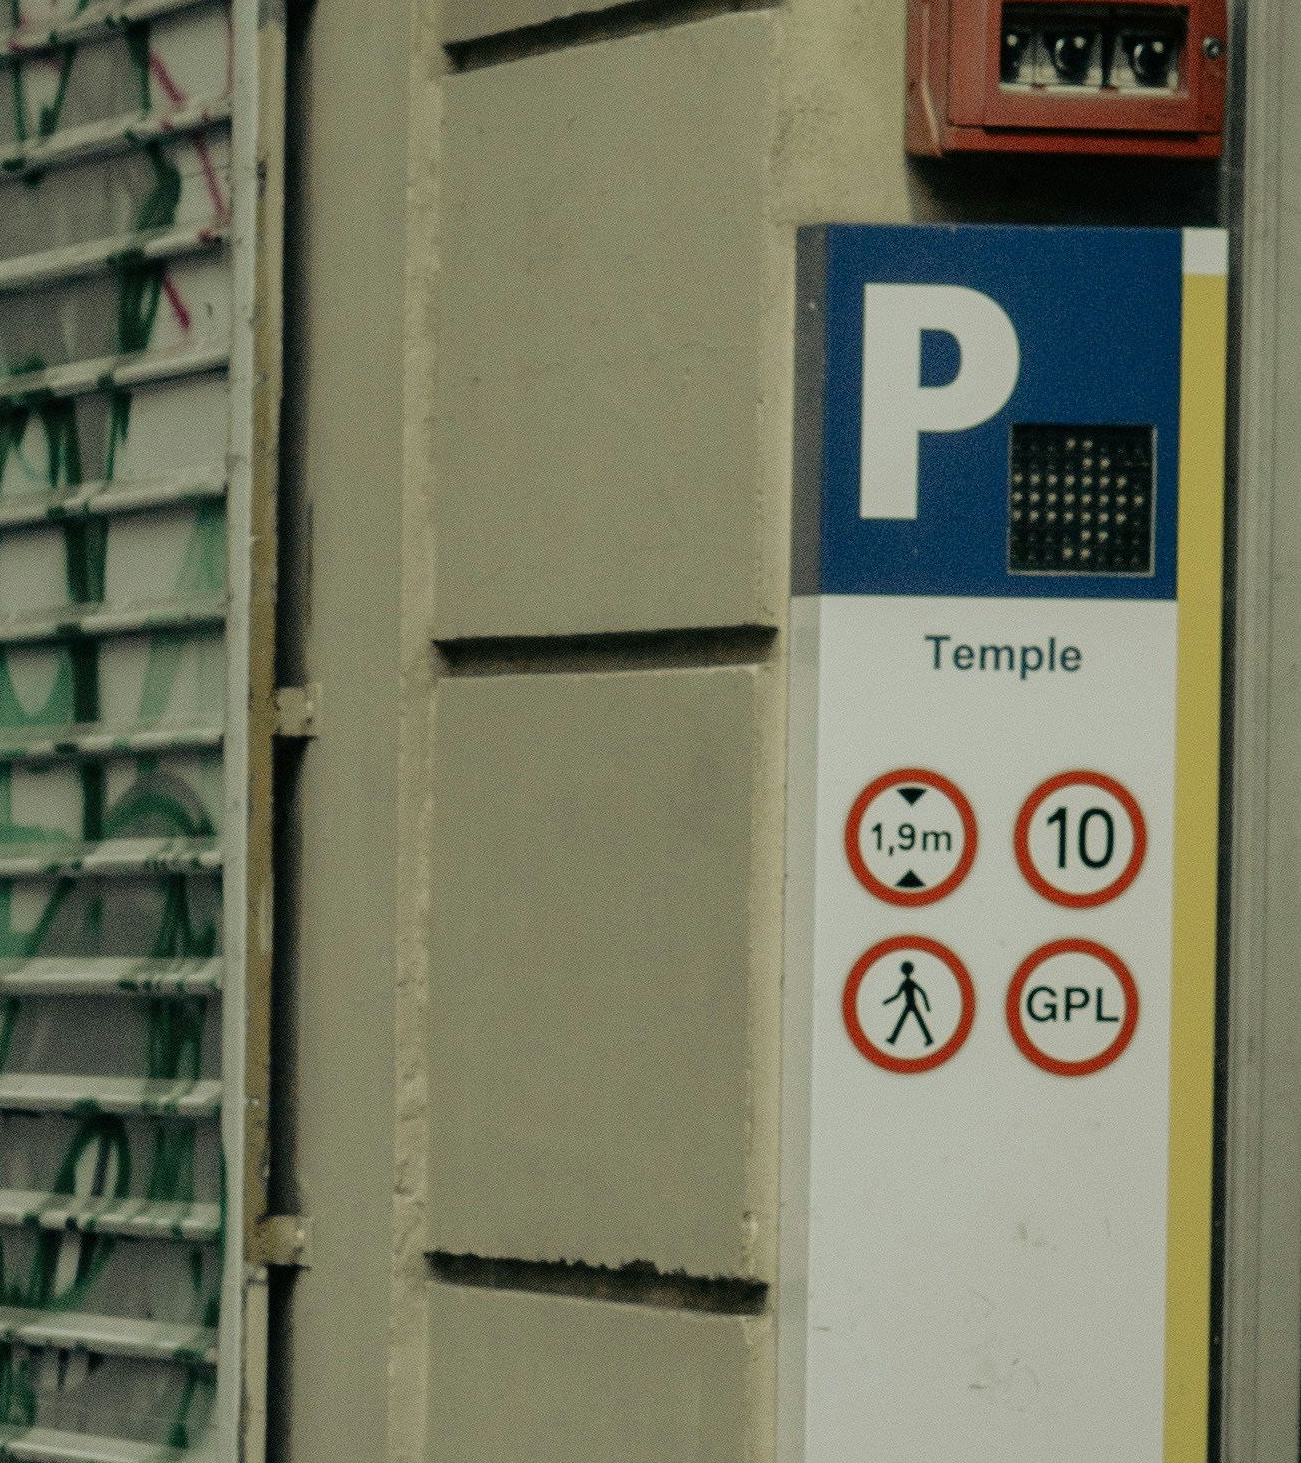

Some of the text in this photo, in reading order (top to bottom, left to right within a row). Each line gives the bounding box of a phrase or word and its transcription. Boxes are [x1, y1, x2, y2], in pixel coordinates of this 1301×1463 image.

[860, 283, 1021, 519] P
[924, 635, 1083, 680] Temple
[1045, 807, 1115, 869] 10
[1026, 986, 1120, 1023] GPL
